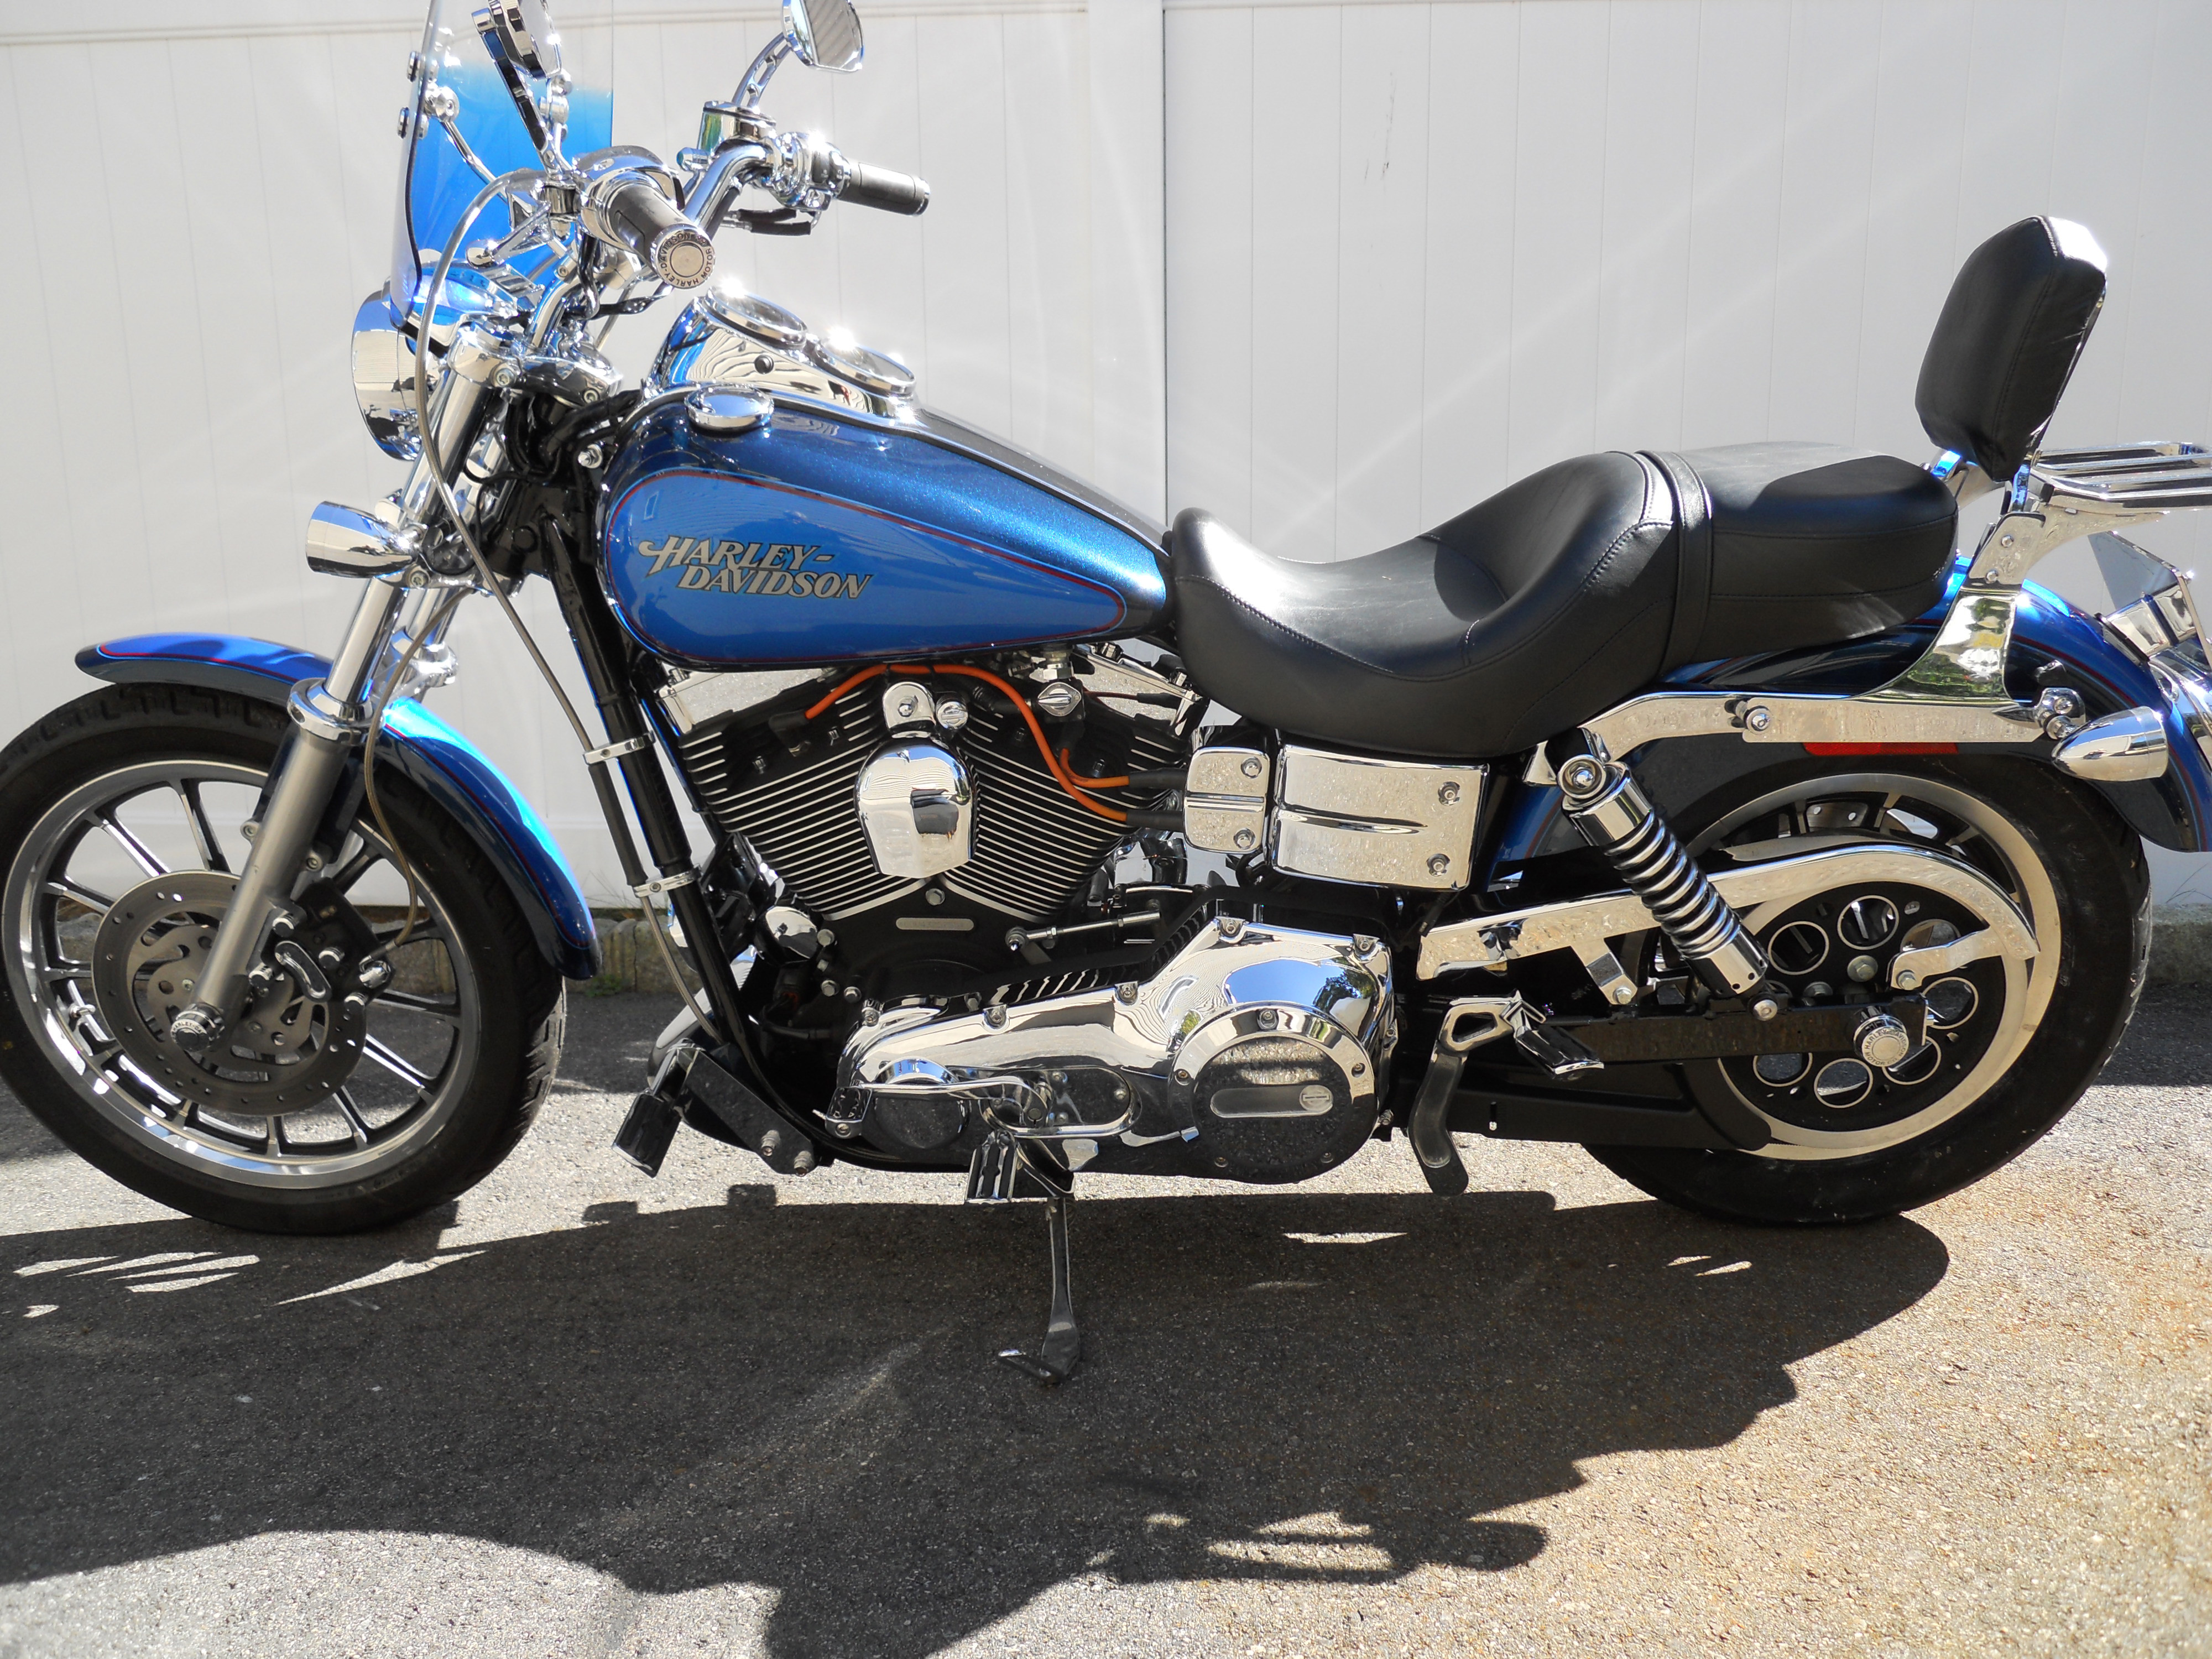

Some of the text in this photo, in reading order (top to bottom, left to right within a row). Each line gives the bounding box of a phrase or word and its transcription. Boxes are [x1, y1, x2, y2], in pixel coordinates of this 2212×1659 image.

[701, 248, 713, 279] MOTOR
[639, 535, 834, 578] HARLEY-
[676, 565, 875, 599] DAVIDSON
[1865, 1052, 1885, 1065] MOTOR
